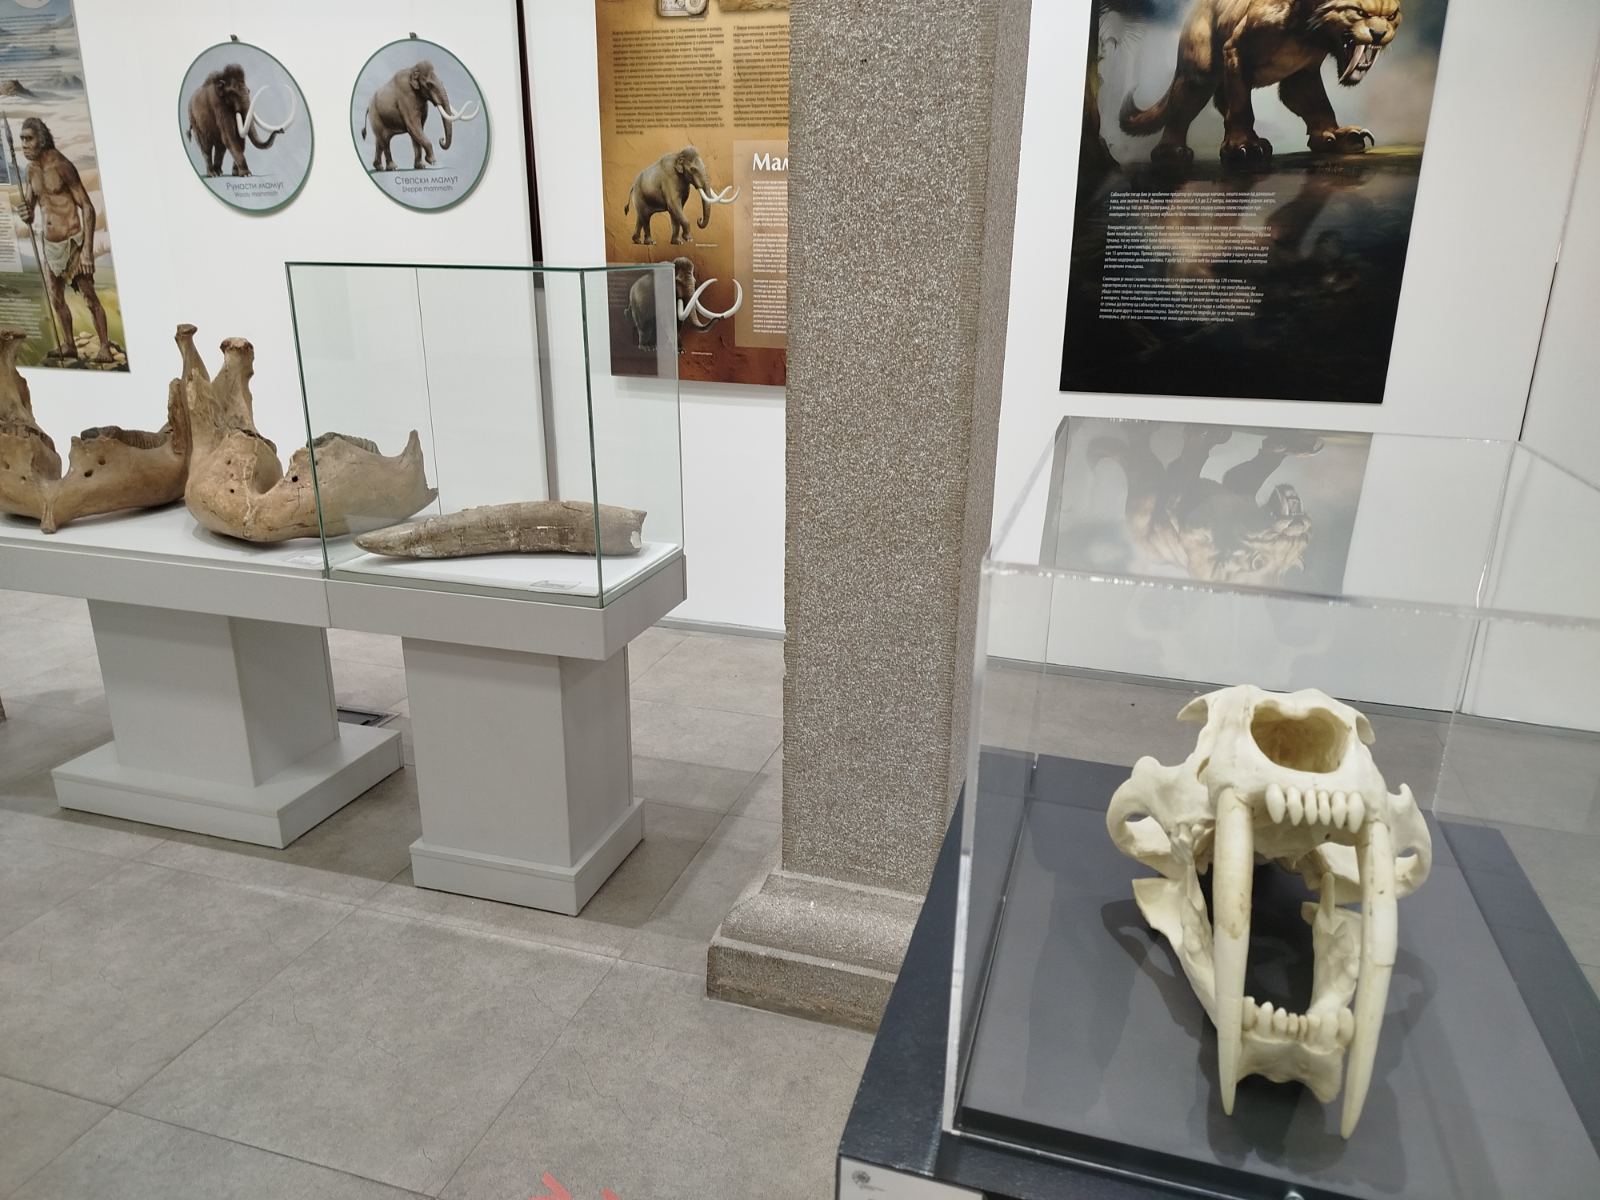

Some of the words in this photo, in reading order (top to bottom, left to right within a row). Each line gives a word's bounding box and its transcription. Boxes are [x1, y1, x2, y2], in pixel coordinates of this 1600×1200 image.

[394, 176, 429, 185] Степски
[430, 175, 458, 185] мамут
[226, 182, 257, 191] Рунасти
[258, 182, 284, 190] мамут
